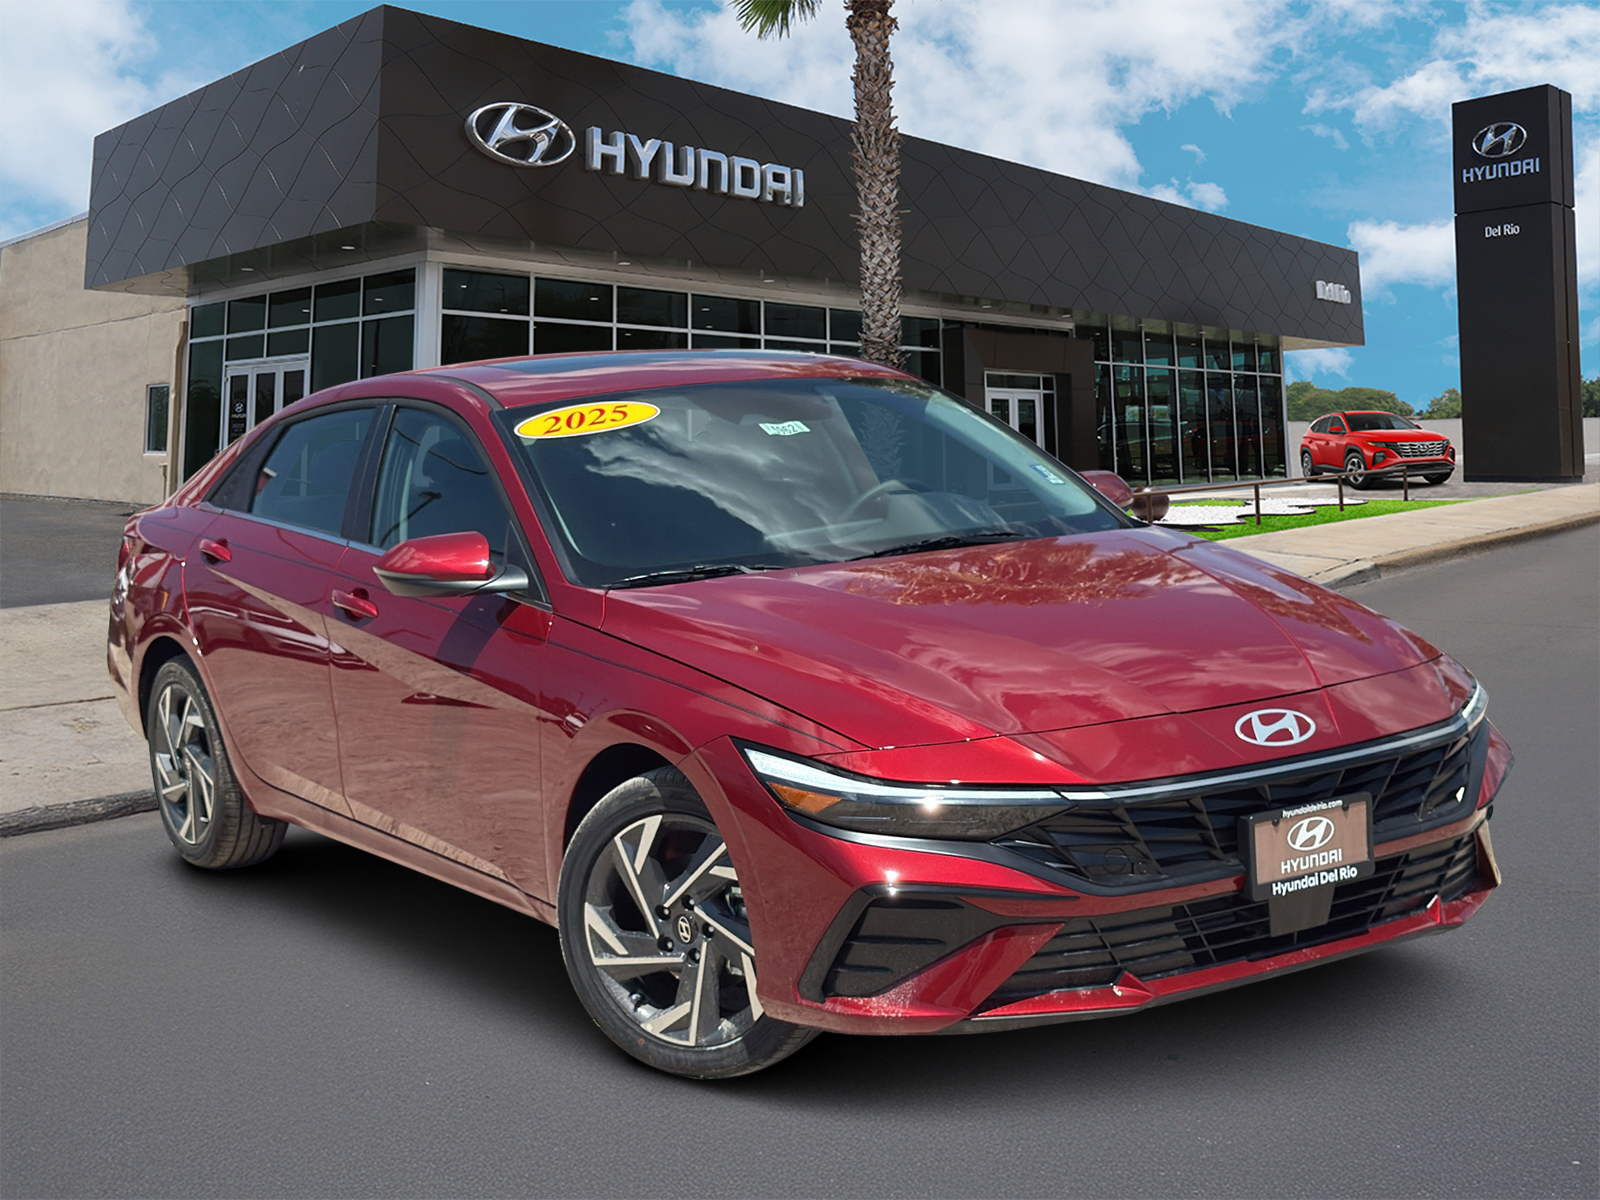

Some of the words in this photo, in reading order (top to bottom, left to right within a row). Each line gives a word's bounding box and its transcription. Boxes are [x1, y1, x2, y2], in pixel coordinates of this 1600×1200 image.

[586, 126, 804, 208] HYUNDAI
[1462, 157, 1540, 183] HYUNDAI
[1484, 225, 1501, 238] Del
[1503, 223, 1520, 236] Rio
[543, 404, 628, 435] 2025
[1281, 848, 1343, 874] HYUNDAI
[1272, 872, 1319, 896] Hyundai
[1319, 868, 1339, 885] Del
[1339, 865, 1358, 881] Rio
